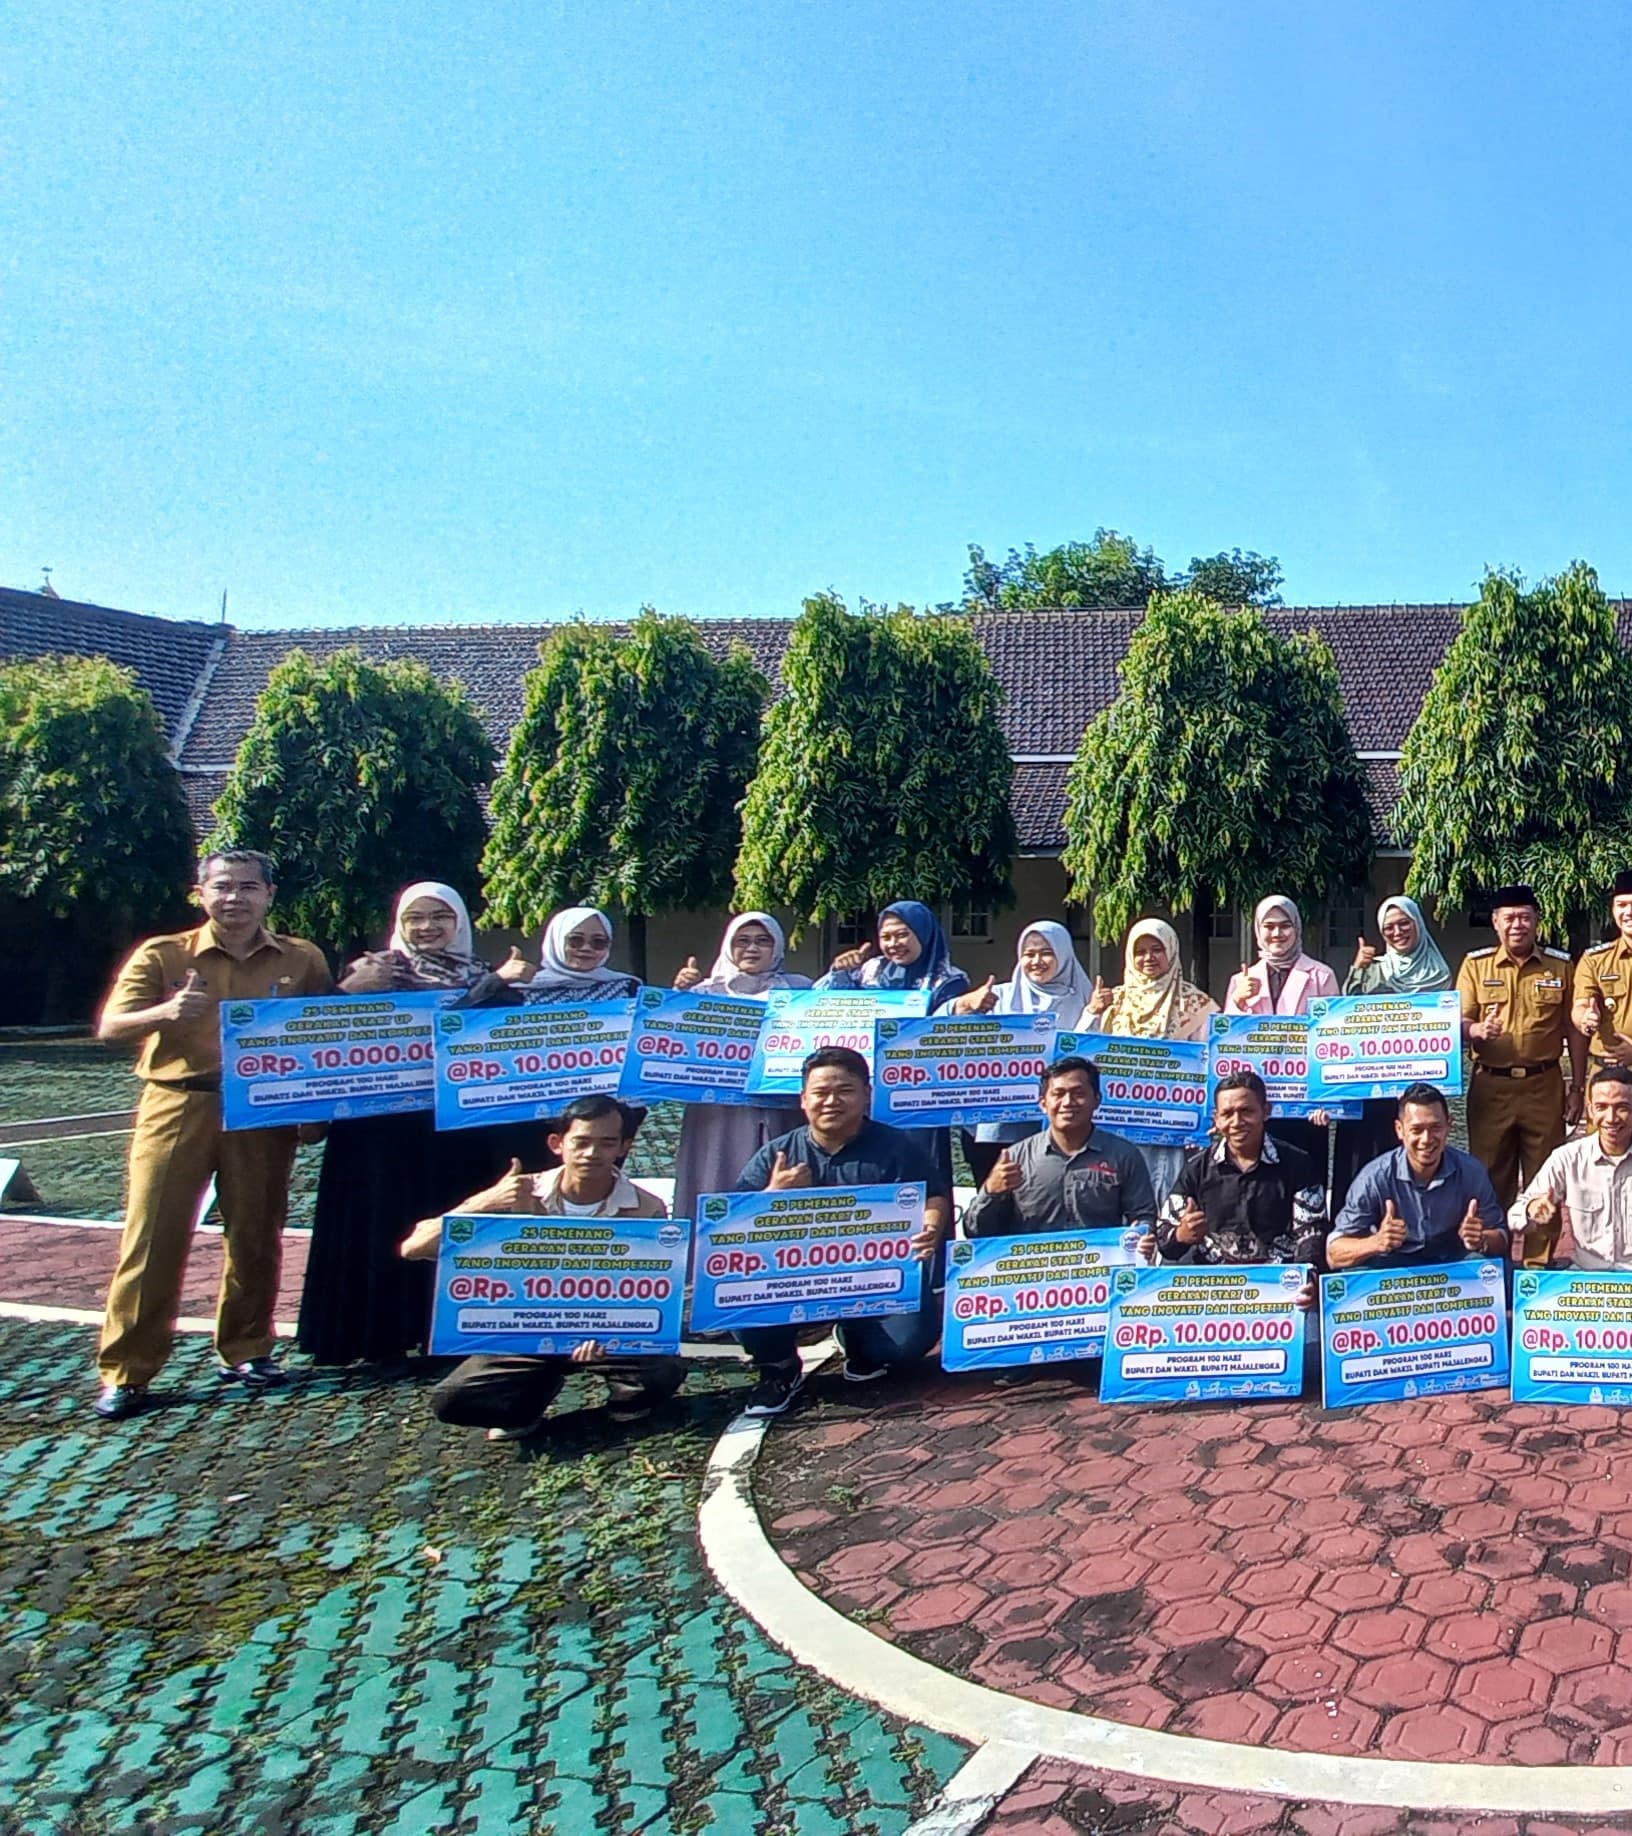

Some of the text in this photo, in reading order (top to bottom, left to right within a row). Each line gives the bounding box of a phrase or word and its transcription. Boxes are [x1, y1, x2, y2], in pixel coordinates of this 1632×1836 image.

[637, 1036, 754, 1061] @Rp. 10.00
[764, 1035, 805, 1053] @Rp.
[1315, 1036, 1451, 1060] @Rp. 10.000.000
[237, 1043, 434, 1077] @Rp. 10.000.0
[448, 1047, 626, 1082] @Rp. 10.000.00
[1261, 1060, 1306, 1076] 10.00
[883, 1060, 1045, 1086] @Rp. 10.000.000
[1107, 1082, 1206, 1105] 10.000.000
[771, 1196, 856, 1211] 25 PEMENANG
[754, 1209, 871, 1227] GERAKAN START UP
[520, 1227, 613, 1240] 25 PEMENANG
[709, 1220, 910, 1245] YANG INOVATIF DAN KOMPETITIF
[501, 1243, 629, 1254] GERAKAN START UP
[706, 1239, 909, 1278] @Rp. 10.000.000
[453, 1257, 672, 1270] YANG INOVATIF DAN KOMPETITIF
[448, 1277, 670, 1301] @Rp. 10.000.000
[955, 1284, 1107, 1318] @Rp. 10.000.0
[1115, 1320, 1293, 1348] @Rp. 10.000.000
[1332, 1314, 1495, 1355] @Rp. 10.000.000
[1522, 1328, 1569, 1351] @Rp.
